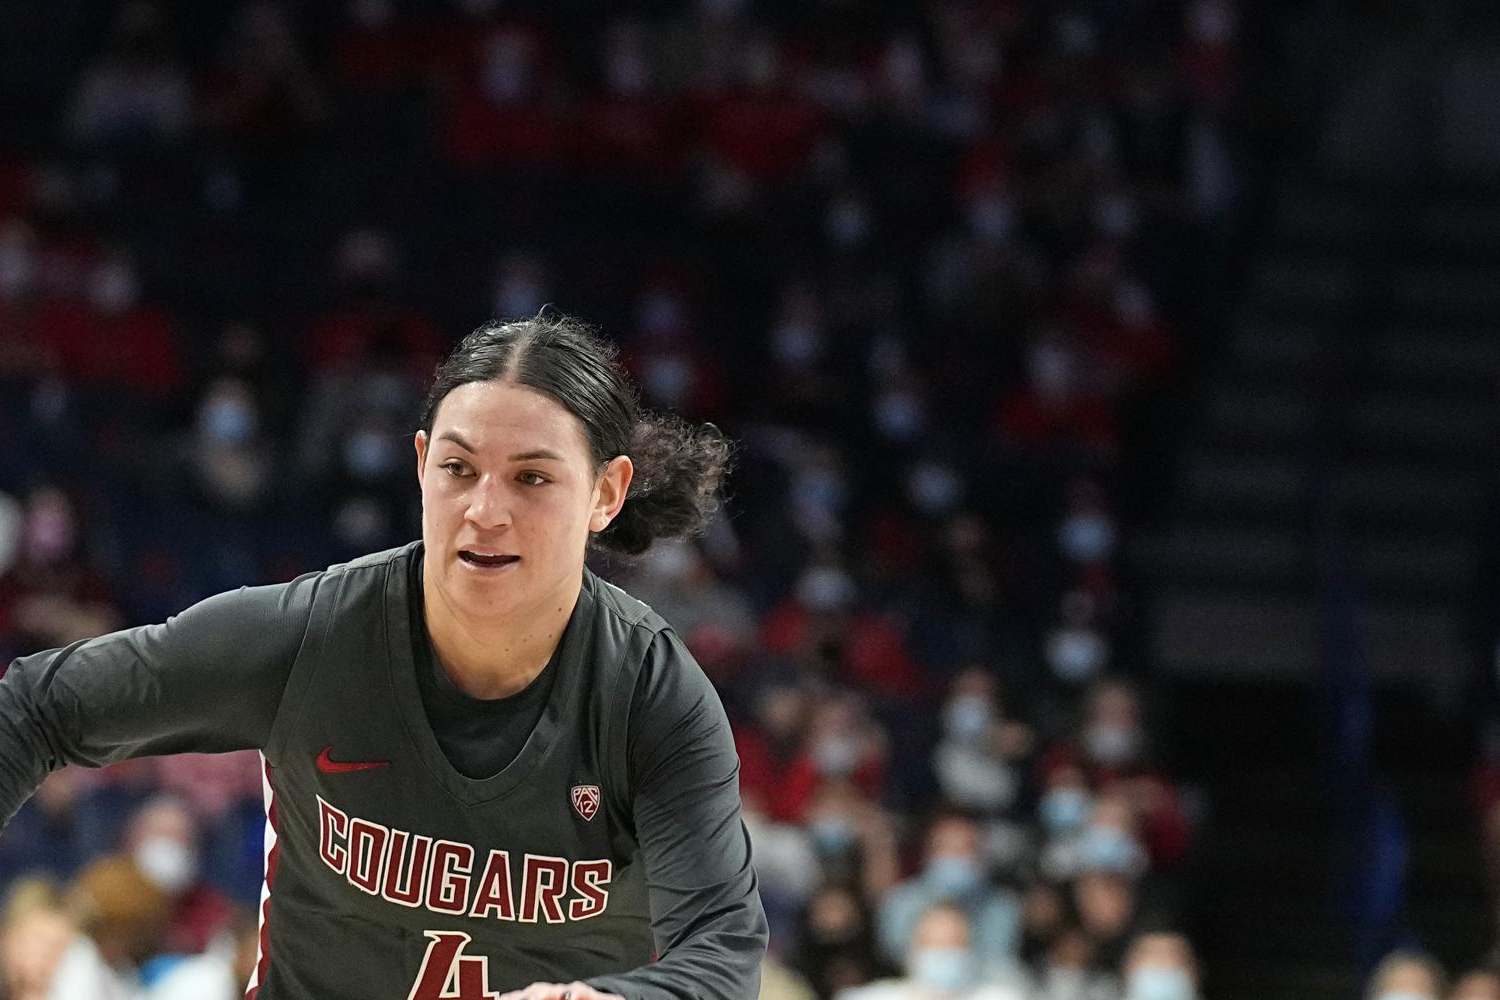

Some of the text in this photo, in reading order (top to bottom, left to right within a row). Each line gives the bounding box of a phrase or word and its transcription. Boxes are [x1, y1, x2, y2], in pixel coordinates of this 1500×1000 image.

[573, 787, 598, 806] PAC
[580, 800, 595, 813] 12
[316, 794, 612, 923] COUGARS
